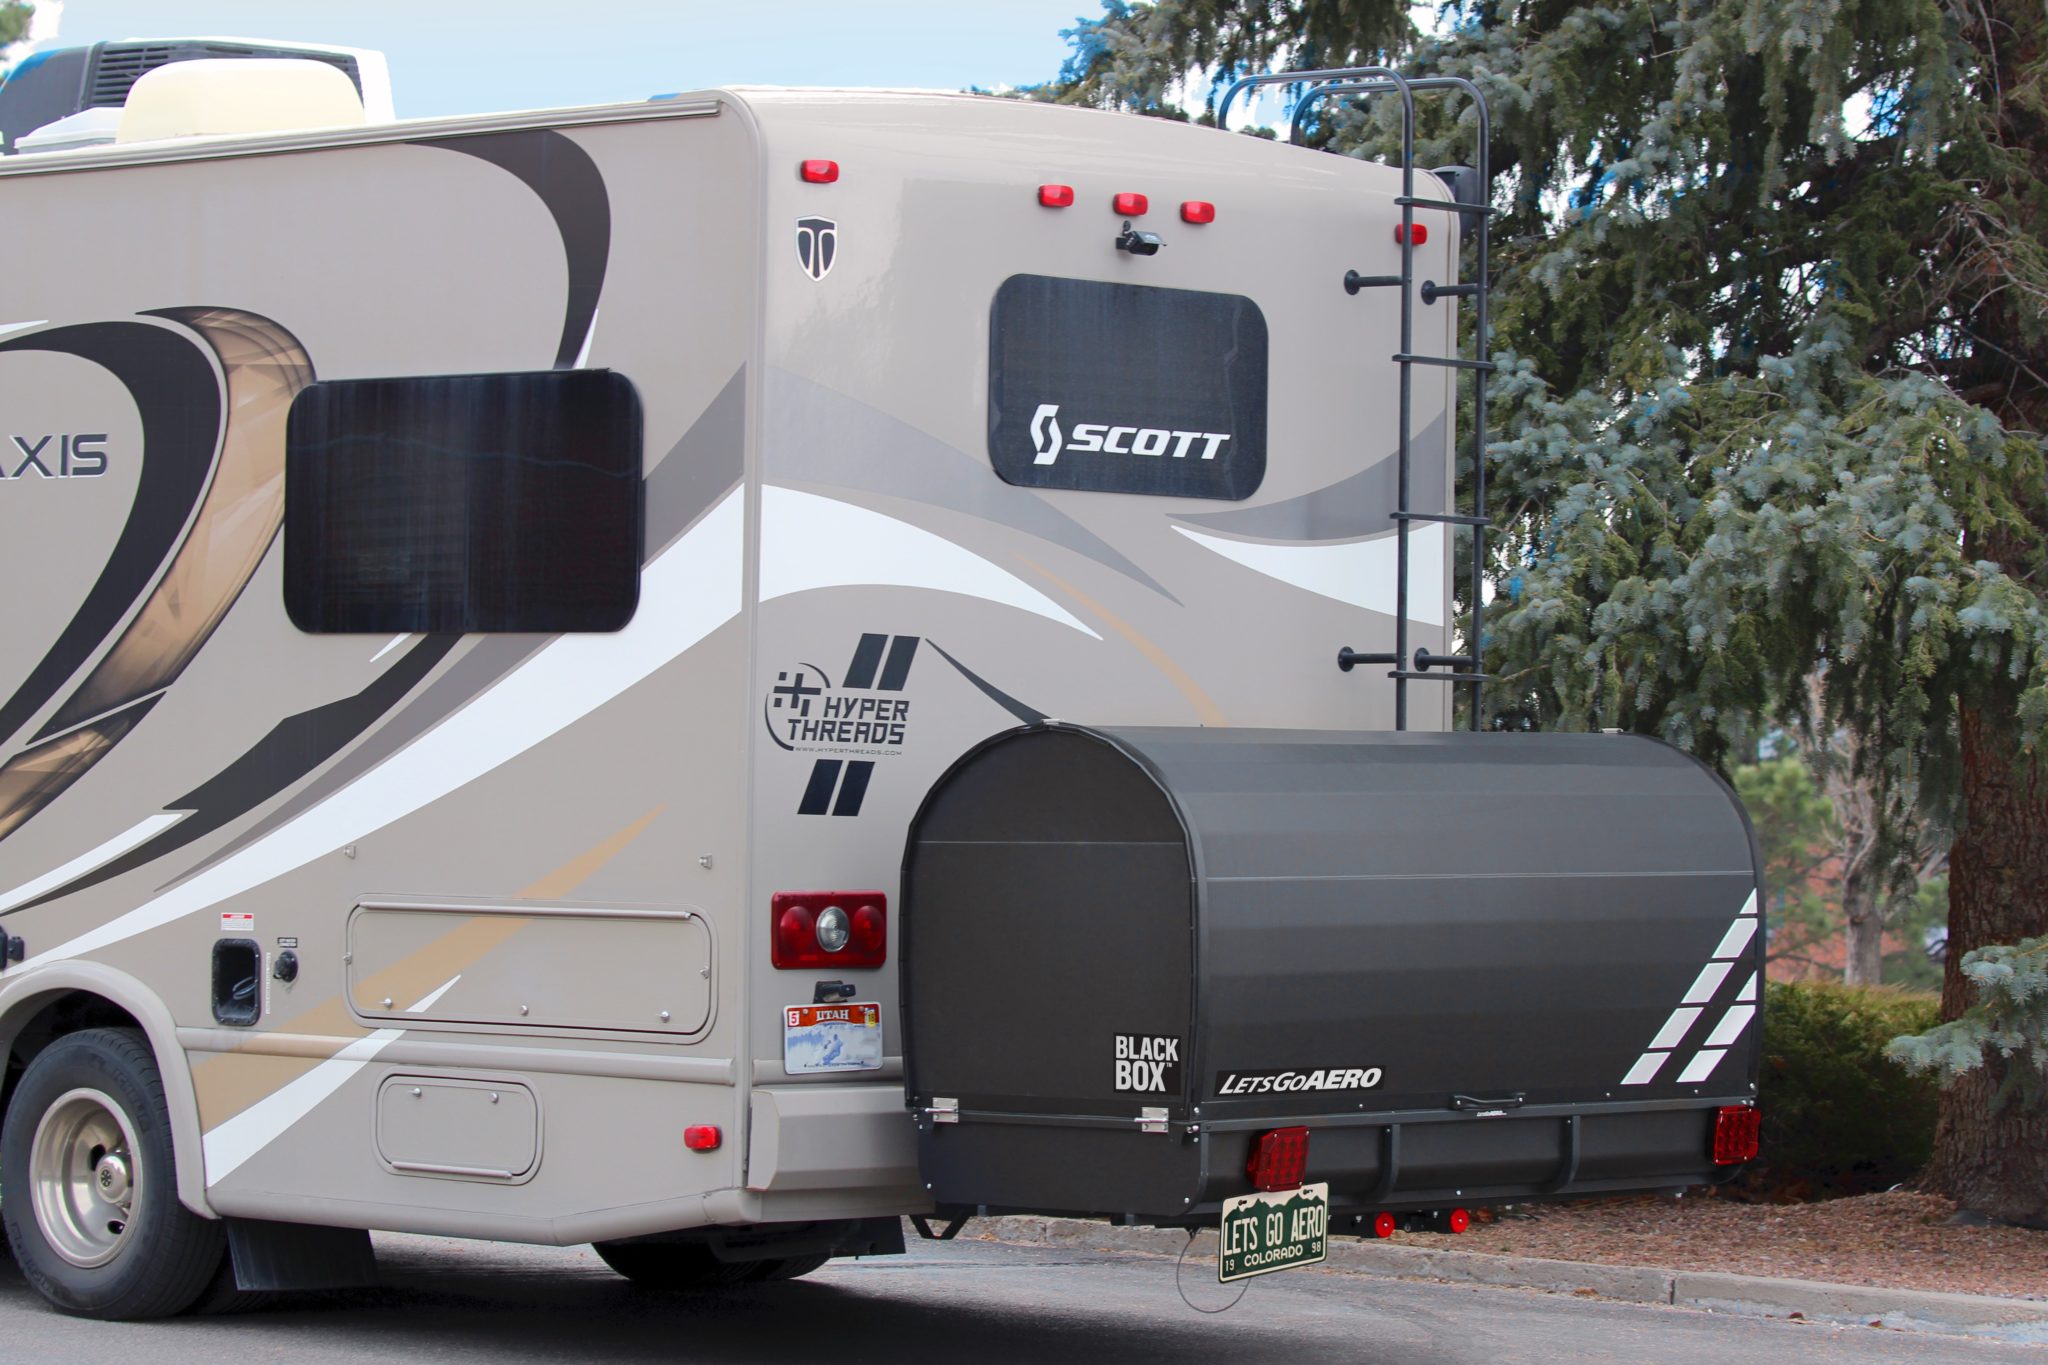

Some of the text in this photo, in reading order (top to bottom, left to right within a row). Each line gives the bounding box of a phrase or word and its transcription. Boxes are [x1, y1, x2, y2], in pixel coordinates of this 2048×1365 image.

[1065, 423, 1231, 460] SCOTT
[0, 433, 108, 479] XIS
[824, 696, 910, 721] HYPER
[787, 718, 906, 745] THREADS
[816, 1009, 850, 1021] UTAH
[1115, 1035, 1179, 1061] BLACK
[1223, 1205, 1324, 1256] LETS GO AERO
[1225, 1241, 1321, 1271] 19 COLORADO 98
